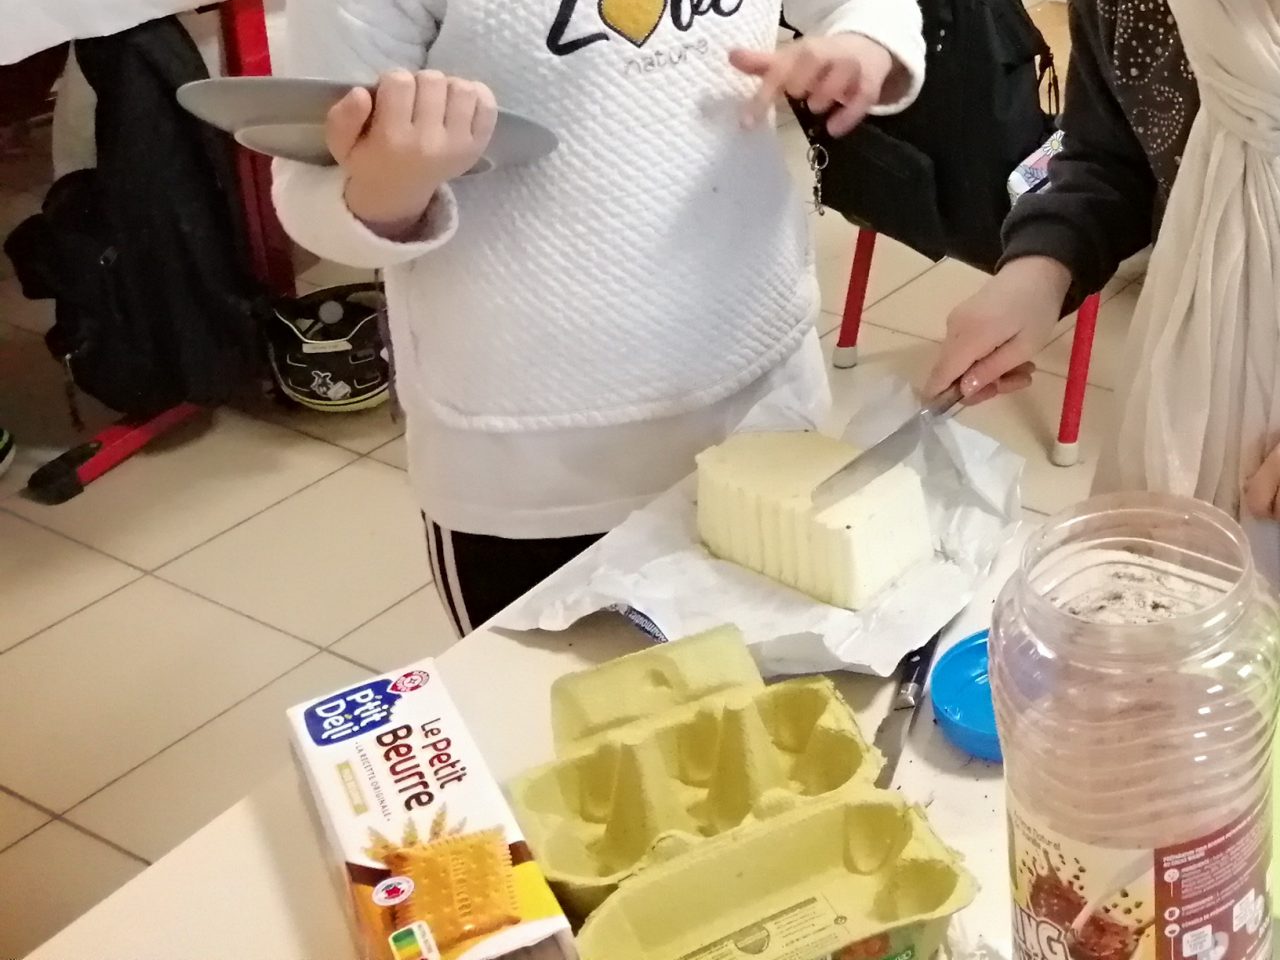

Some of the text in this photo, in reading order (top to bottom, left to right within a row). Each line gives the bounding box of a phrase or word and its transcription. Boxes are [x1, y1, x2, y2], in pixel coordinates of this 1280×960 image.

[314, 698, 361, 741] Déli
[346, 687, 391, 728] P'tit
[375, 723, 435, 812] Beurre
[420, 717, 468, 790] Le Petit
[370, 780, 391, 818] ORIGINALE
